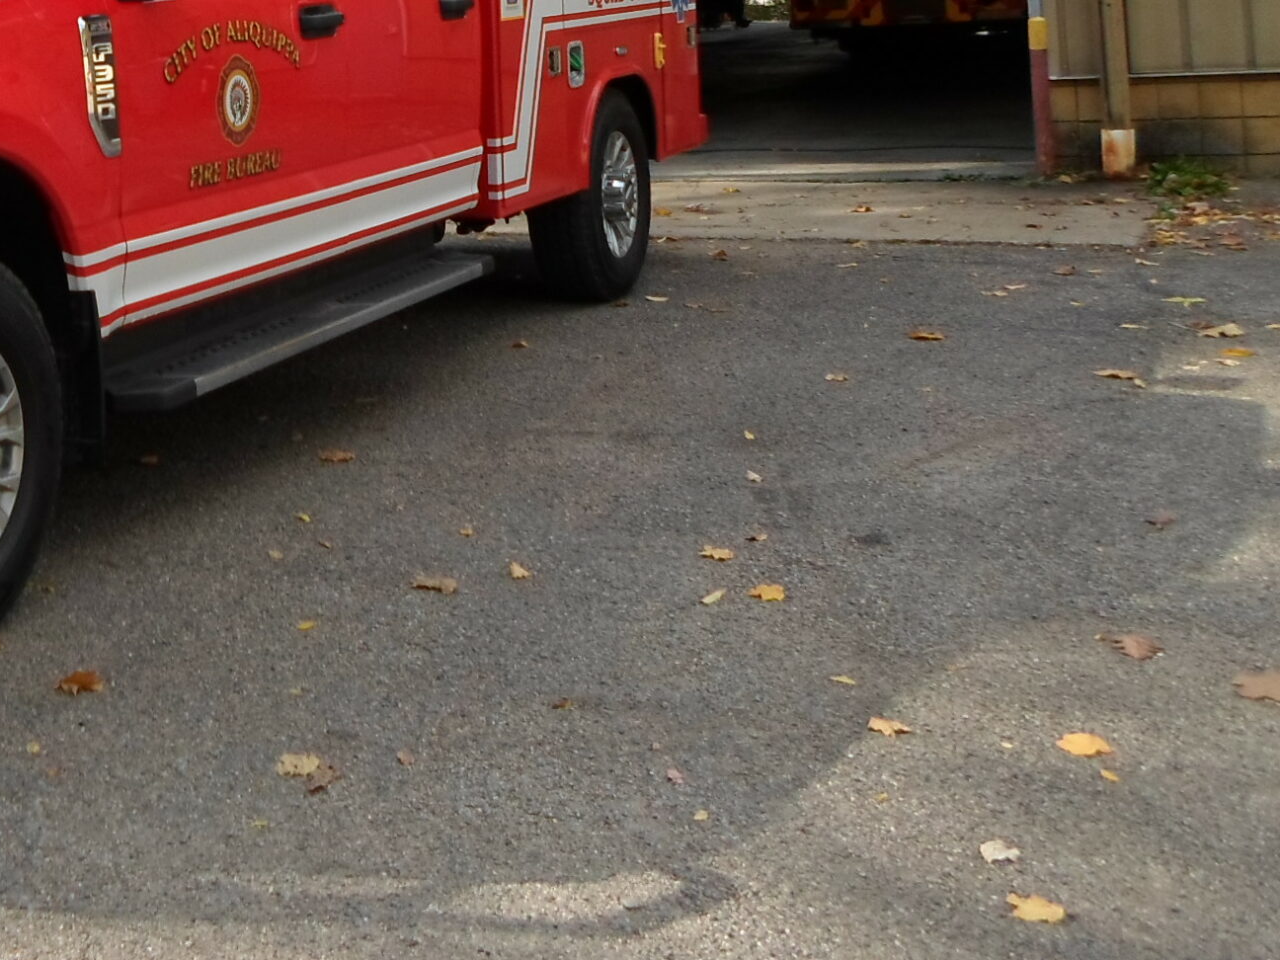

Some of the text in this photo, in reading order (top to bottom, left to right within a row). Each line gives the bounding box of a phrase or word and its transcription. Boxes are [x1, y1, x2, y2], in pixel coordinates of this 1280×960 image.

[163, 19, 301, 83] CITY OF ALIQUIPPA
[189, 149, 282, 189] FIRE BUREAU
